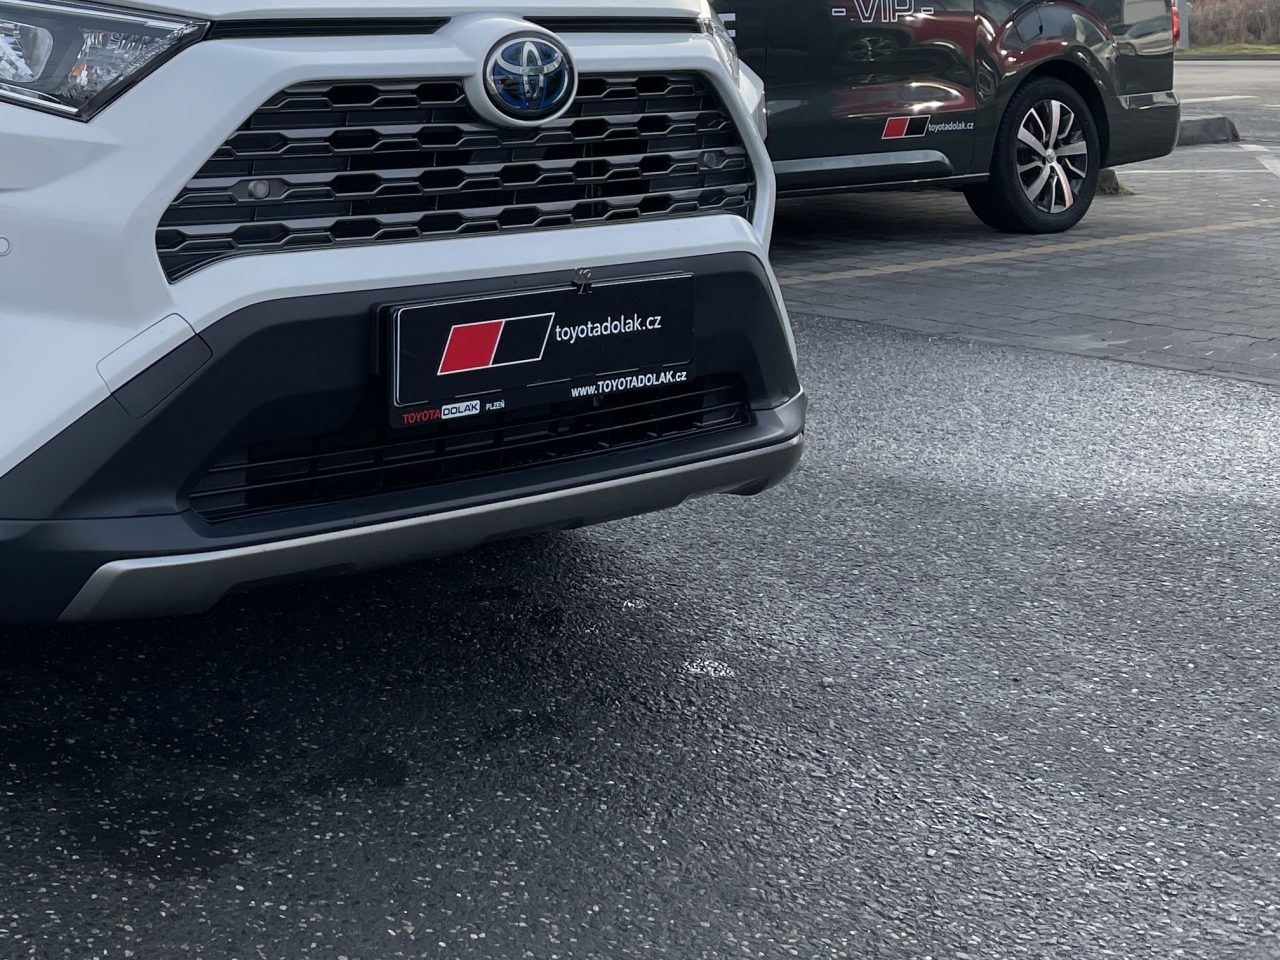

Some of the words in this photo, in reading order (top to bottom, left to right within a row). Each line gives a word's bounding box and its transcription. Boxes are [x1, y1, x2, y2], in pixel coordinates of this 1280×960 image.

[928, 121, 974, 133] toyotadolak.cz
[555, 313, 662, 344] toyotadolak.cz
[571, 371, 687, 398] www.TOYOTADOLAK.cz
[403, 409, 440, 424] TOYOTA
